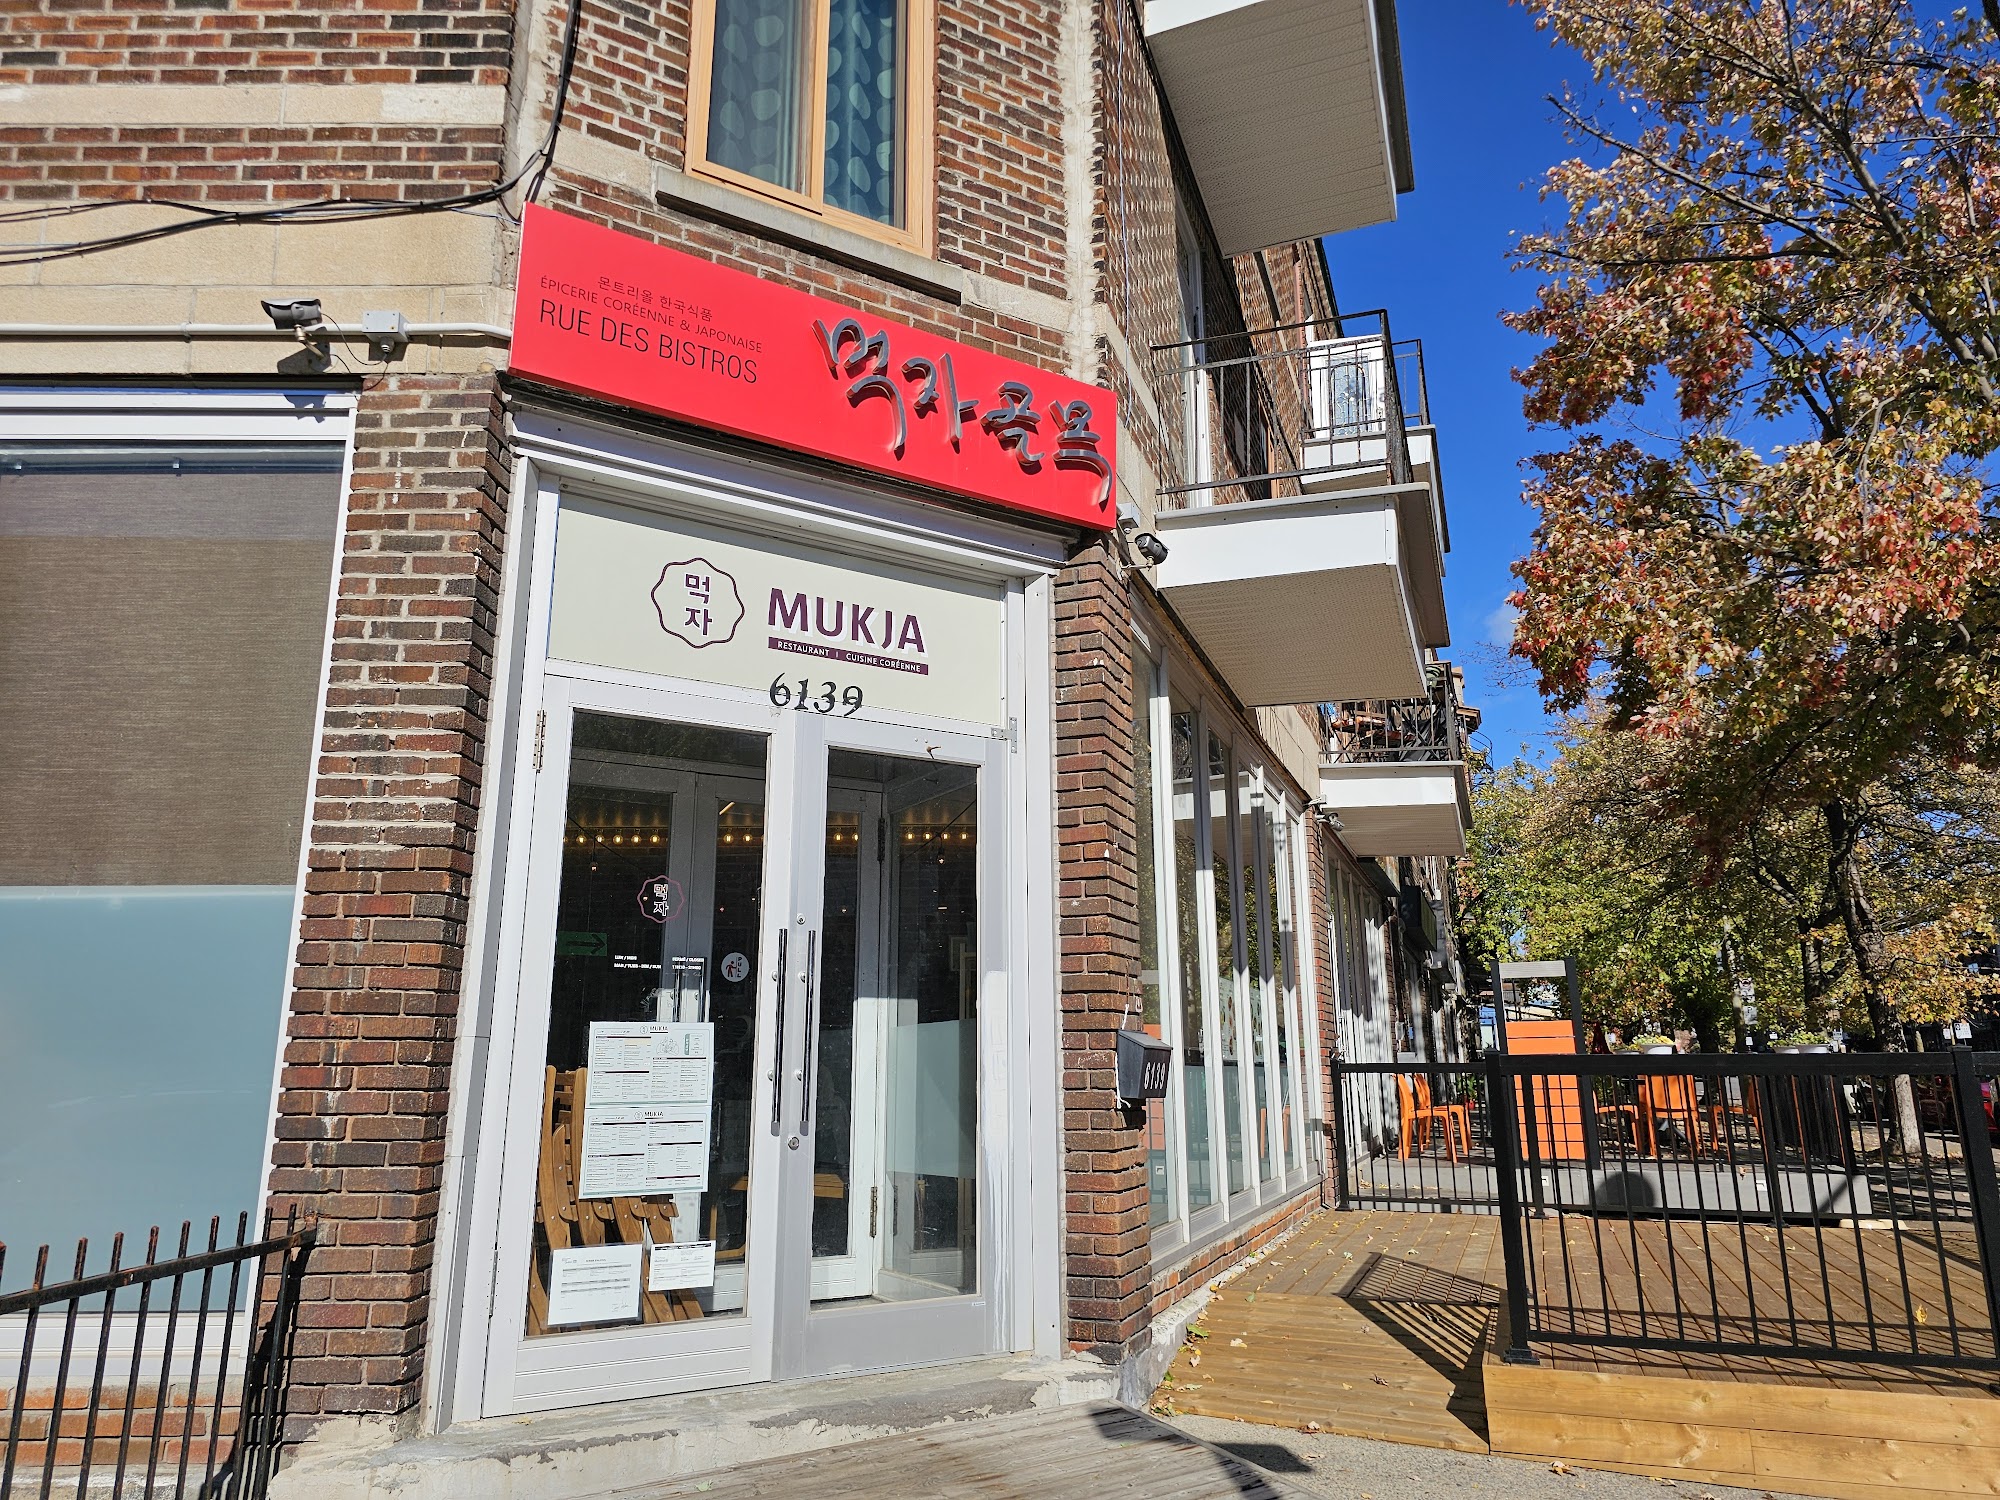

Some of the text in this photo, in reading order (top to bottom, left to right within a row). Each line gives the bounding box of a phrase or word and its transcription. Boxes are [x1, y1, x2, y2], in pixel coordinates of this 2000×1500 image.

[540, 275, 763, 353] ÉPICERIE CORÉENNE & JAPONAISE
[597, 276, 713, 322] 몬트리올 한국식품
[540, 298, 758, 384] RUE DES BISTROS
[684, 573, 713, 636] 먹자
[768, 587, 926, 653] MUKJA
[777, 640, 921, 673] RESTAURANT CUISINE CORÉENNE
[769, 672, 864, 717] 6139
[1144, 1061, 1166, 1090] 6139
